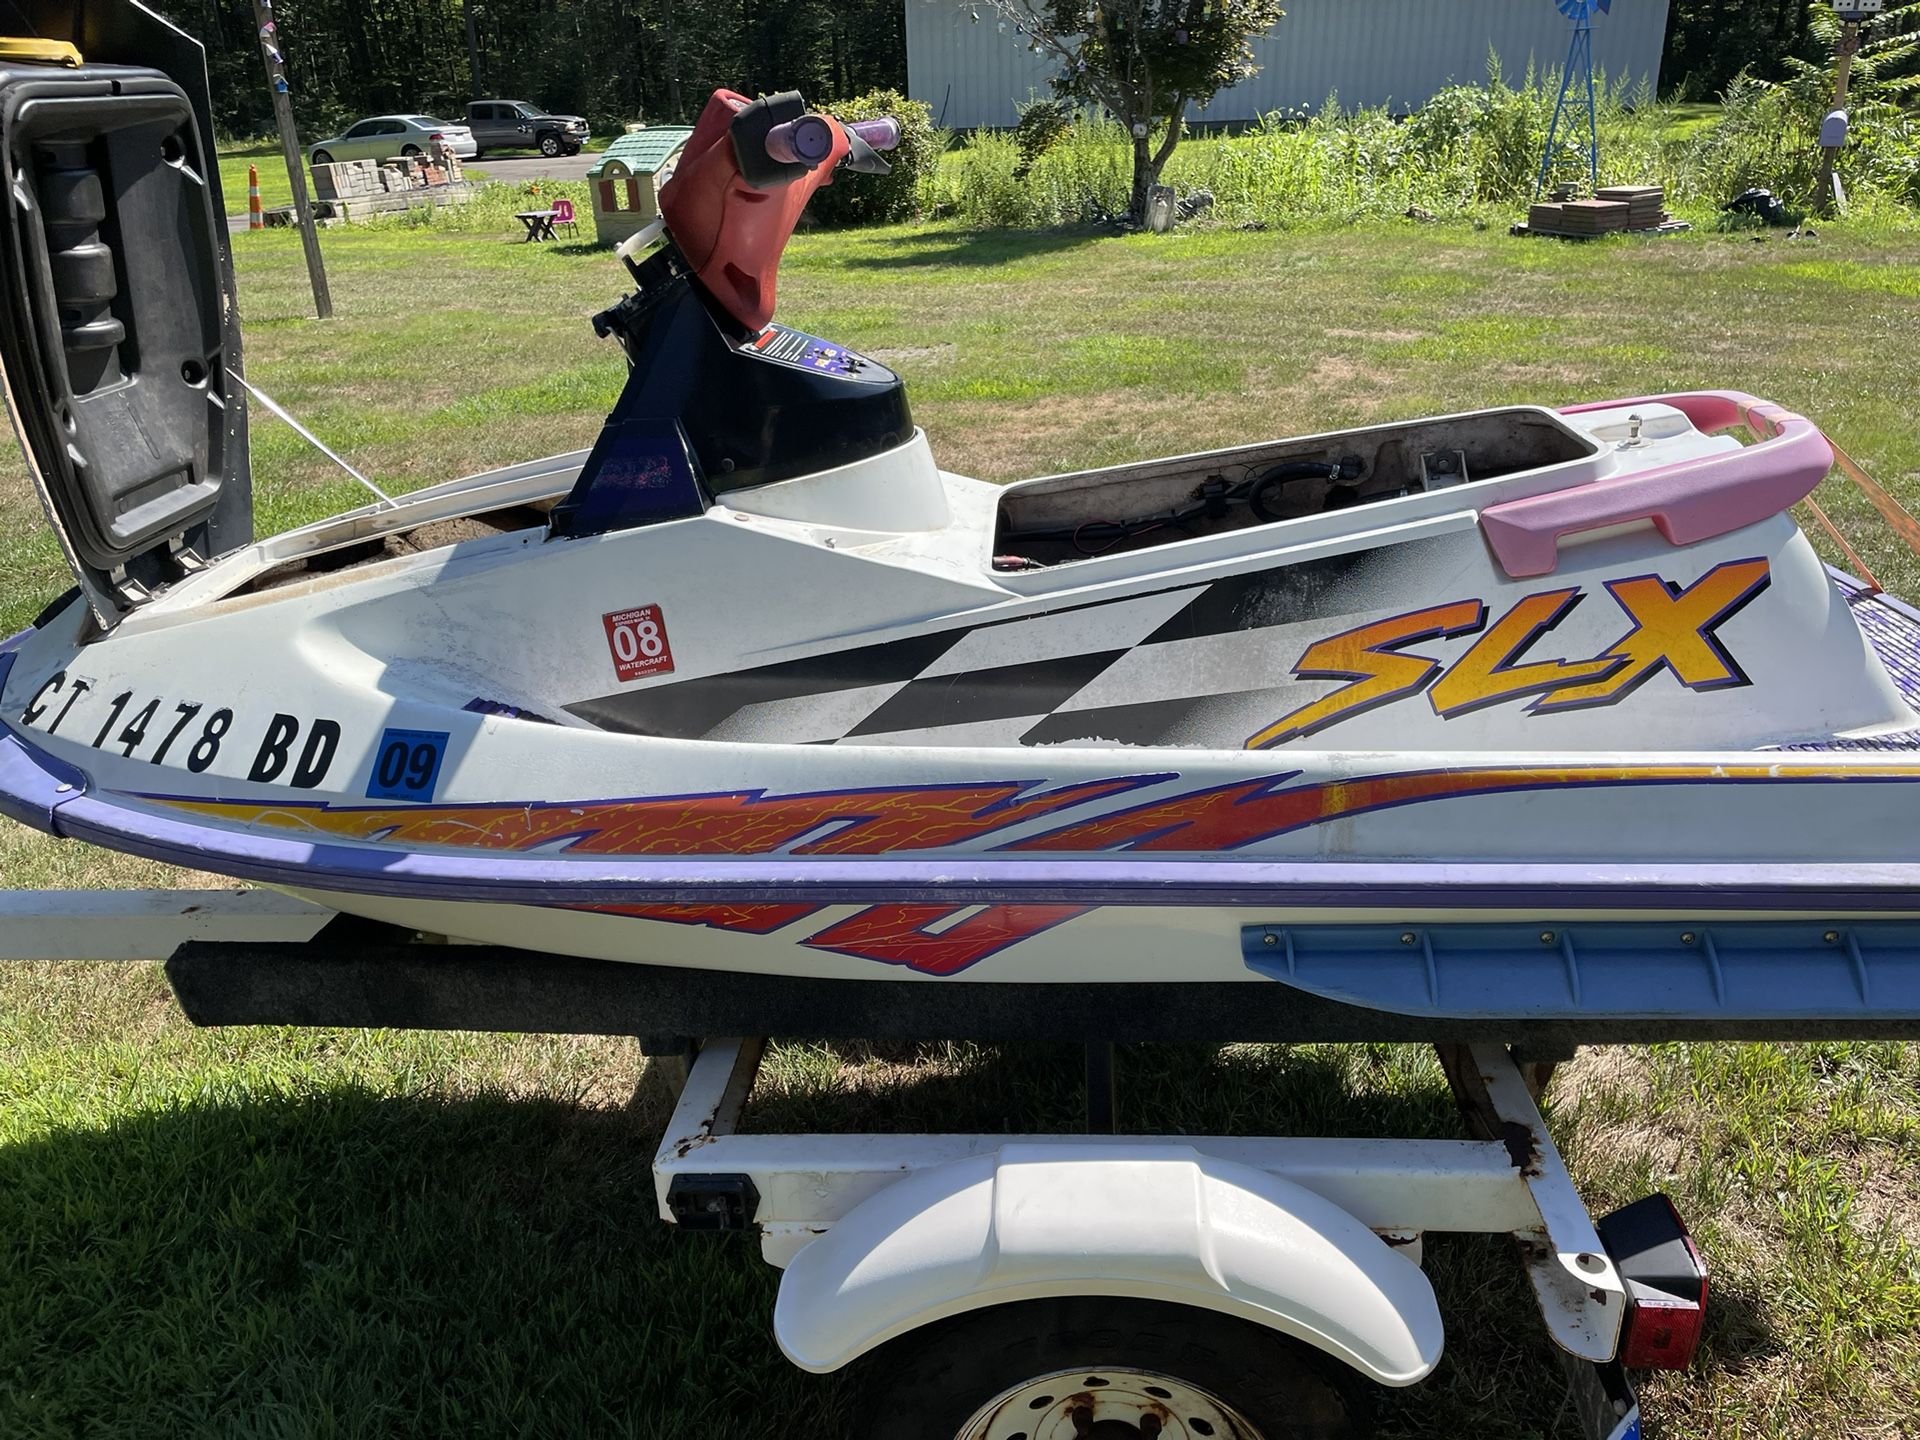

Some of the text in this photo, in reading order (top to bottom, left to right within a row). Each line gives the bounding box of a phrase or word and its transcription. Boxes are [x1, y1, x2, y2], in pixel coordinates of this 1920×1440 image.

[612, 608, 651, 623] MICHIGAN
[613, 620, 663, 662] 08
[619, 655, 668, 671] WATERCRAFT
[1243, 556, 1772, 750] SLX
[21, 671, 341, 788] CT 1478 BD
[378, 741, 437, 790] 09
